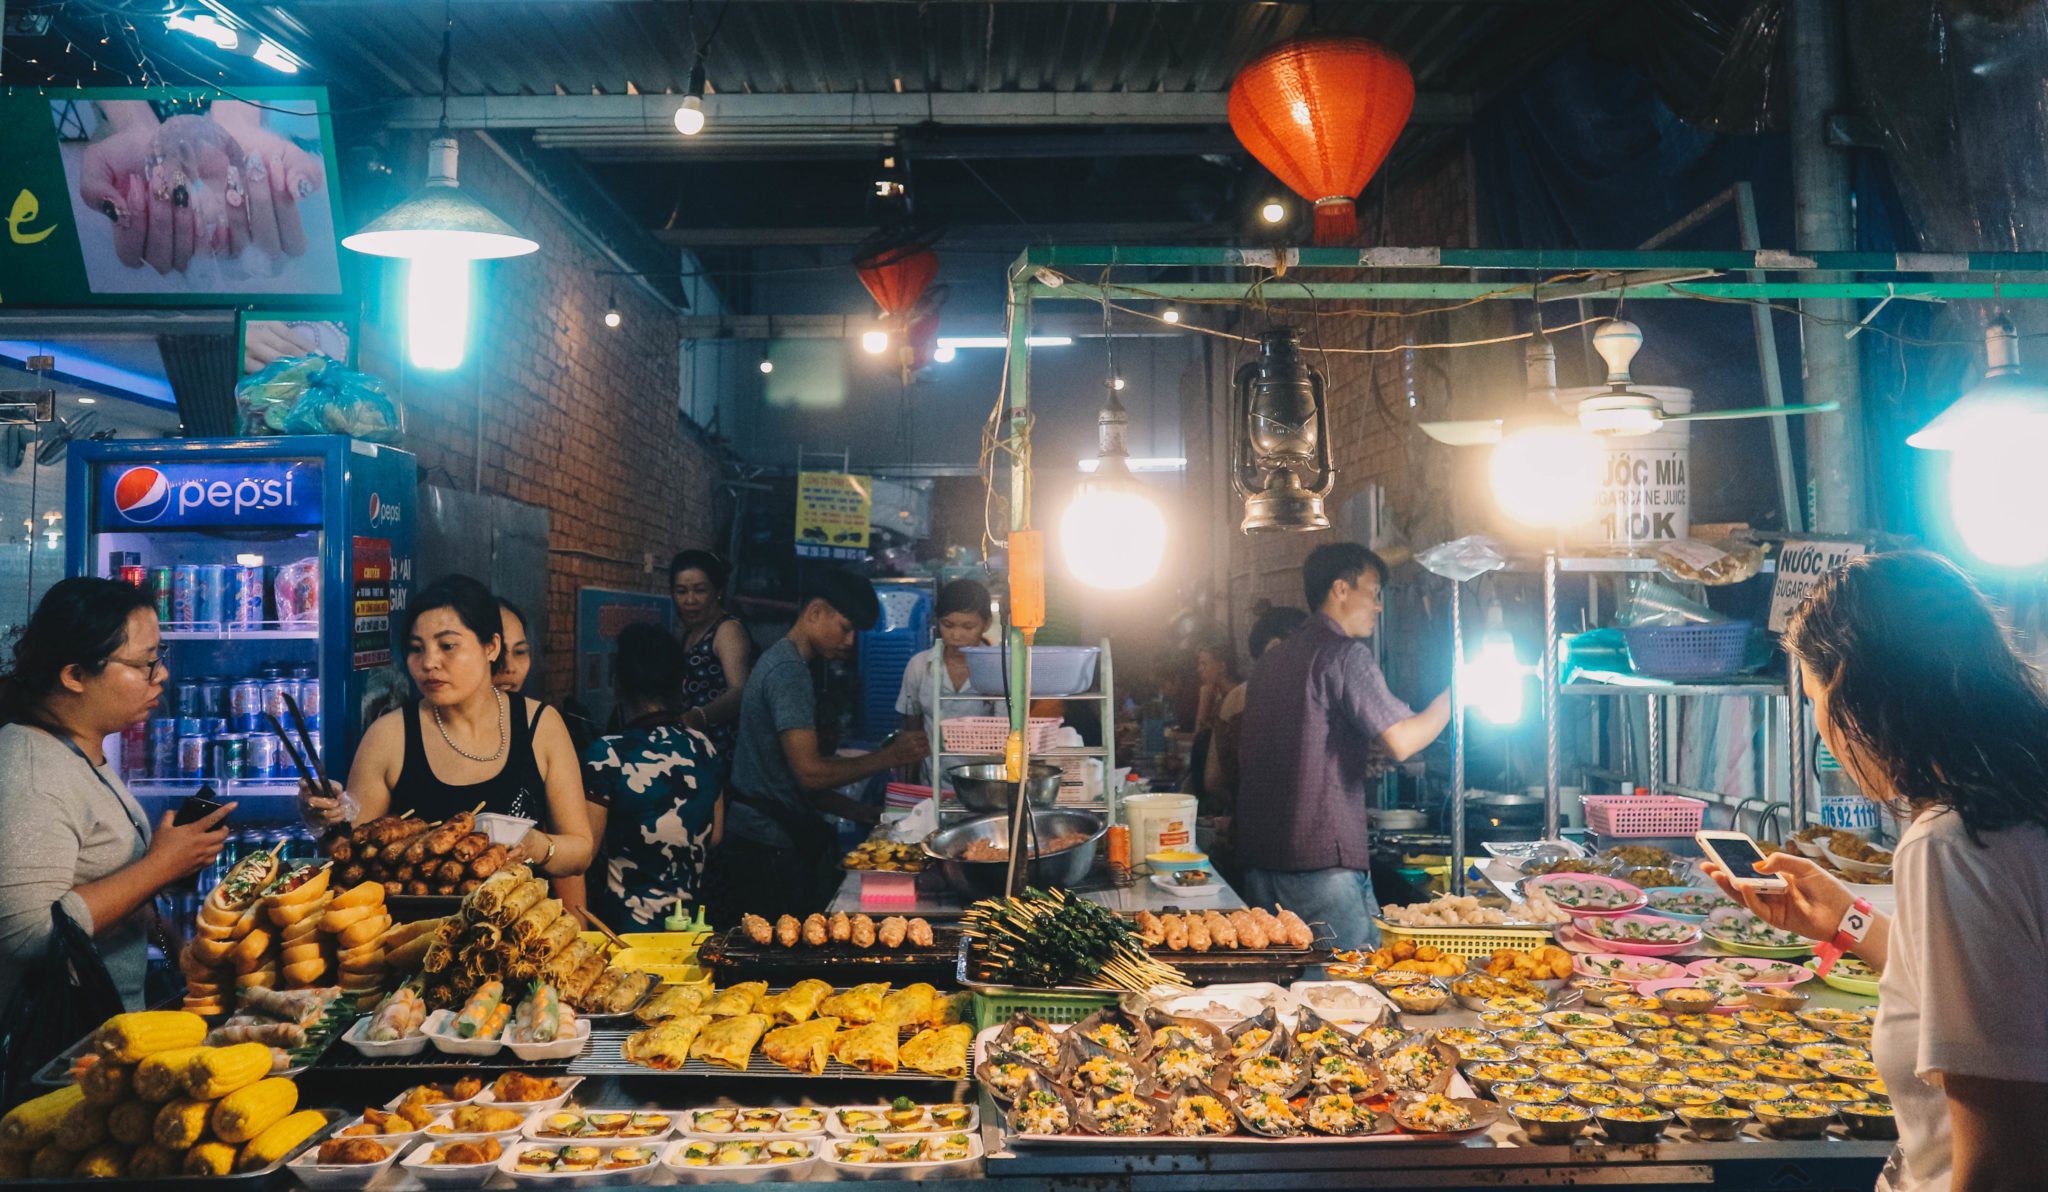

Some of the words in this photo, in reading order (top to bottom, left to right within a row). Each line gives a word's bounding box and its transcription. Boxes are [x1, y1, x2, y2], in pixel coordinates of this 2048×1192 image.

[1603, 452, 1649, 486] ƯỚC
[1655, 452, 1686, 486] MÍA
[179, 470, 294, 516] pepsi
[1663, 490, 1686, 505] JUICE
[380, 502, 401, 526] pepsi
[1600, 512, 1677, 540] 10K
[1780, 546, 1823, 576] NƯỚC
[1827, 548, 1850, 570] MÍ
